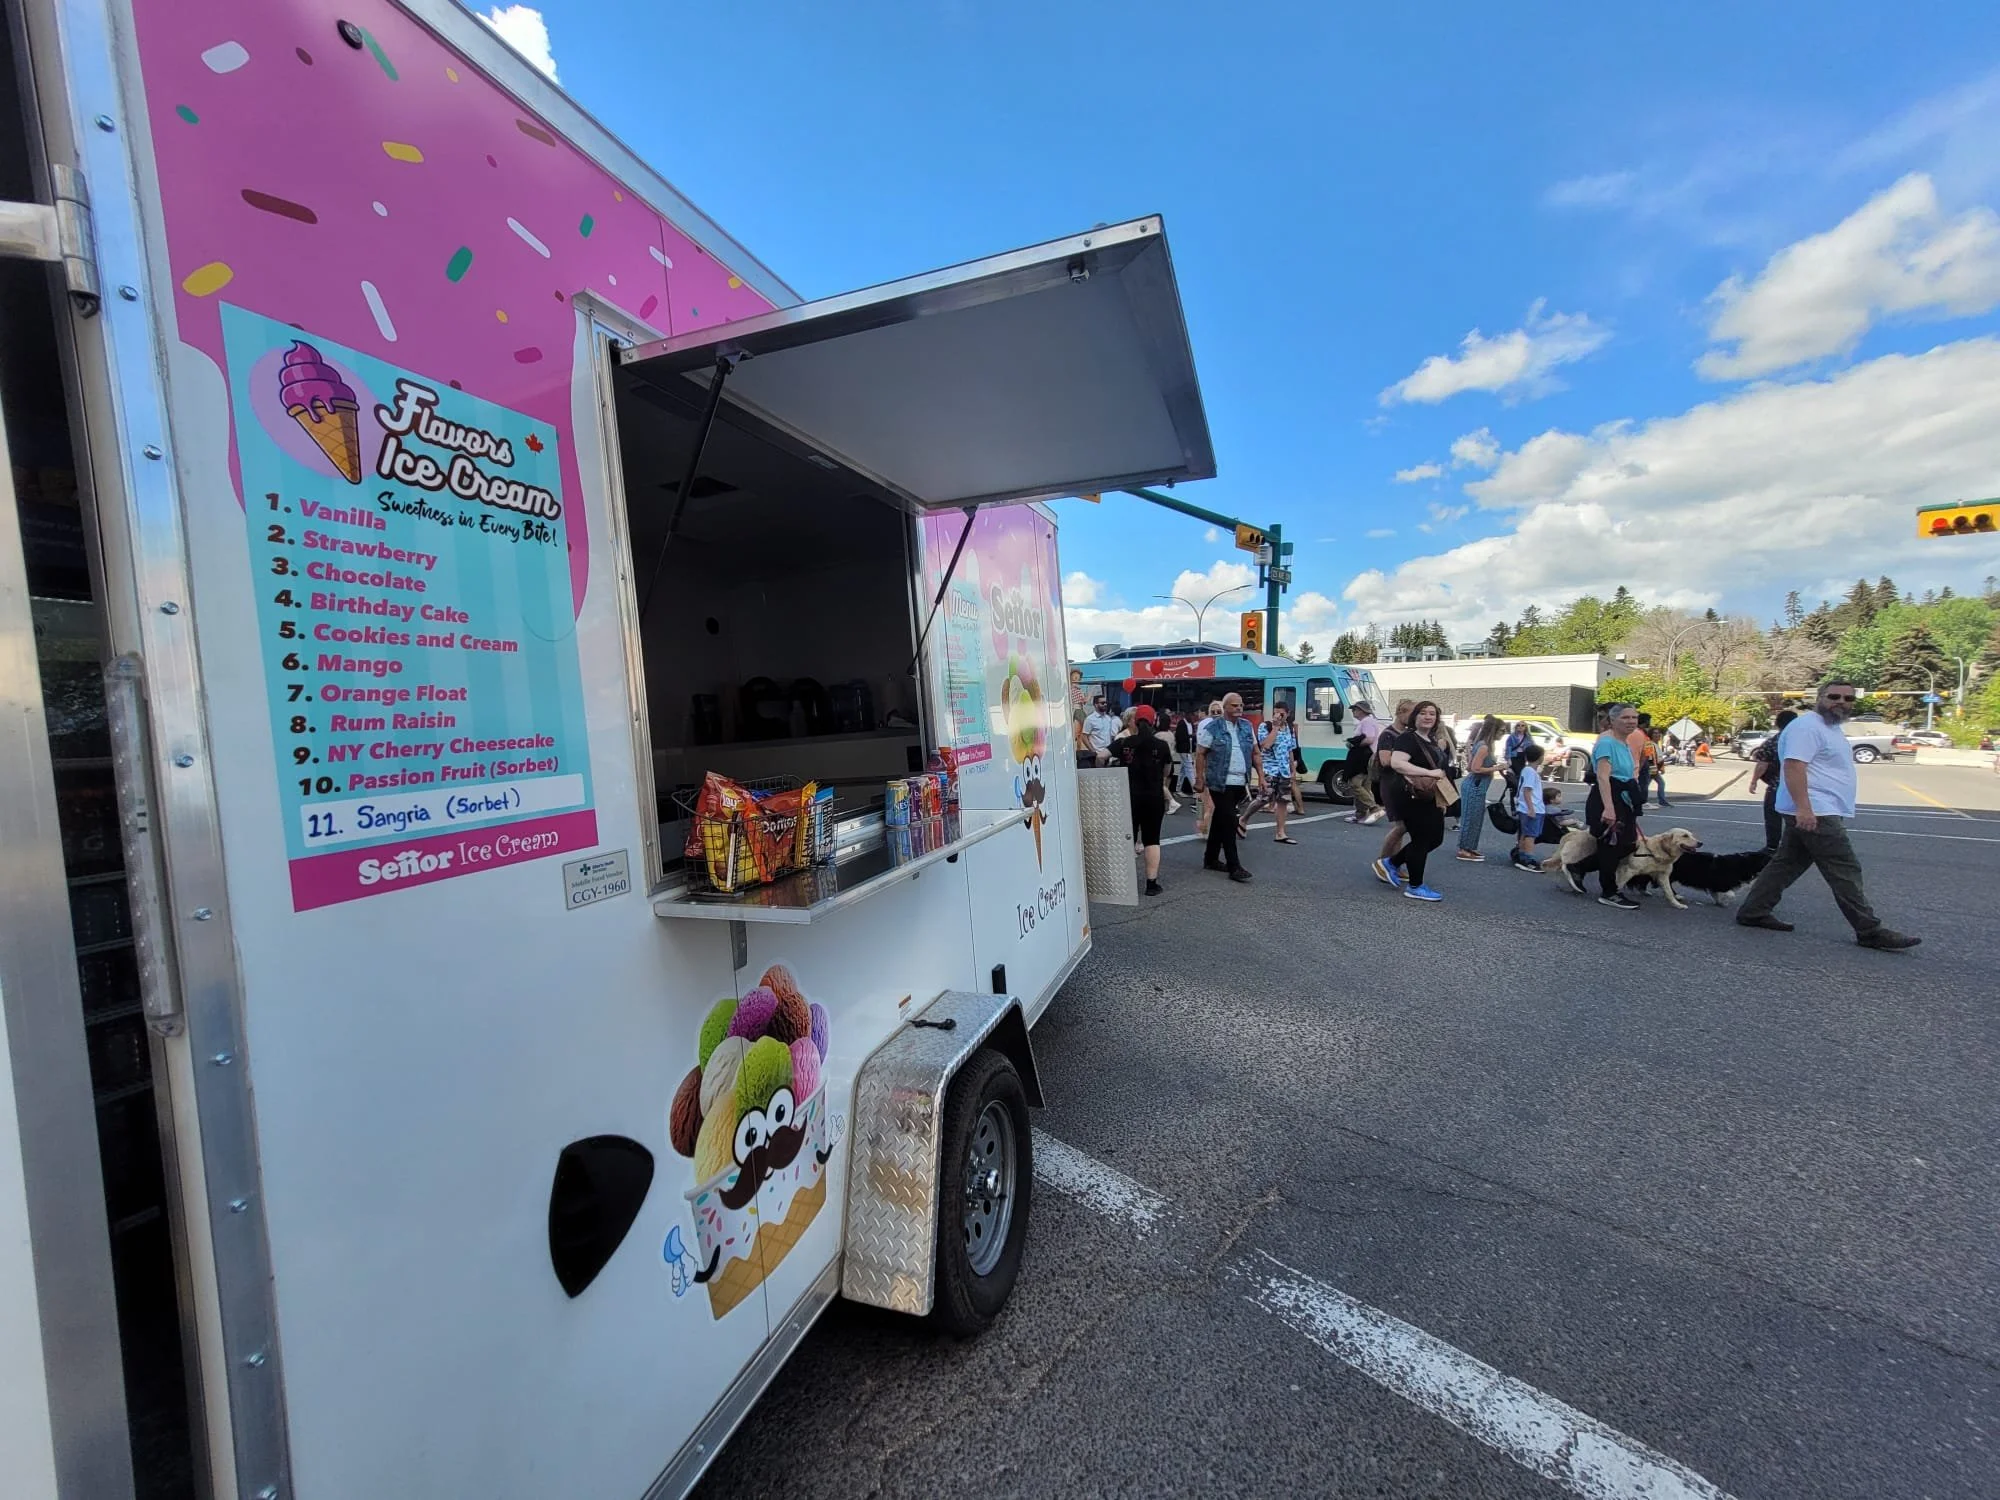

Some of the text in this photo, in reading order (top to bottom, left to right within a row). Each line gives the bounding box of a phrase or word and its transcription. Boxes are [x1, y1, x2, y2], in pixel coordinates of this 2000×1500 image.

[375, 379, 514, 466] Flavors
[376, 433, 561, 520] Ice Cream
[265, 493, 386, 530] 1. Vanilla
[378, 491, 558, 547] Sweetness in Every Bite!
[267, 525, 438, 570] 2. Strawberry
[271, 557, 426, 592] 3. Chocolate
[274, 589, 469, 623] 4. Birthday Cake
[990, 584, 1040, 640] Señor
[278, 621, 518, 652] 5. Cookies and Cream
[282, 653, 403, 677] 6. Mango
[287, 684, 467, 706] 7. Orange Float
[290, 711, 456, 733] 8. Rum Raisin
[293, 733, 555, 765] 9. NY Cherry Cheesecake
[299, 756, 559, 796] 10. Passion Fruit (Sorbet)
[308, 787, 520, 838] 11. Sangria (Sorbet)
[358, 831, 559, 885] Señor Ice Cream
[572, 879, 626, 903] CGY-1960
[1016, 877, 1066, 940] Ice Cream
